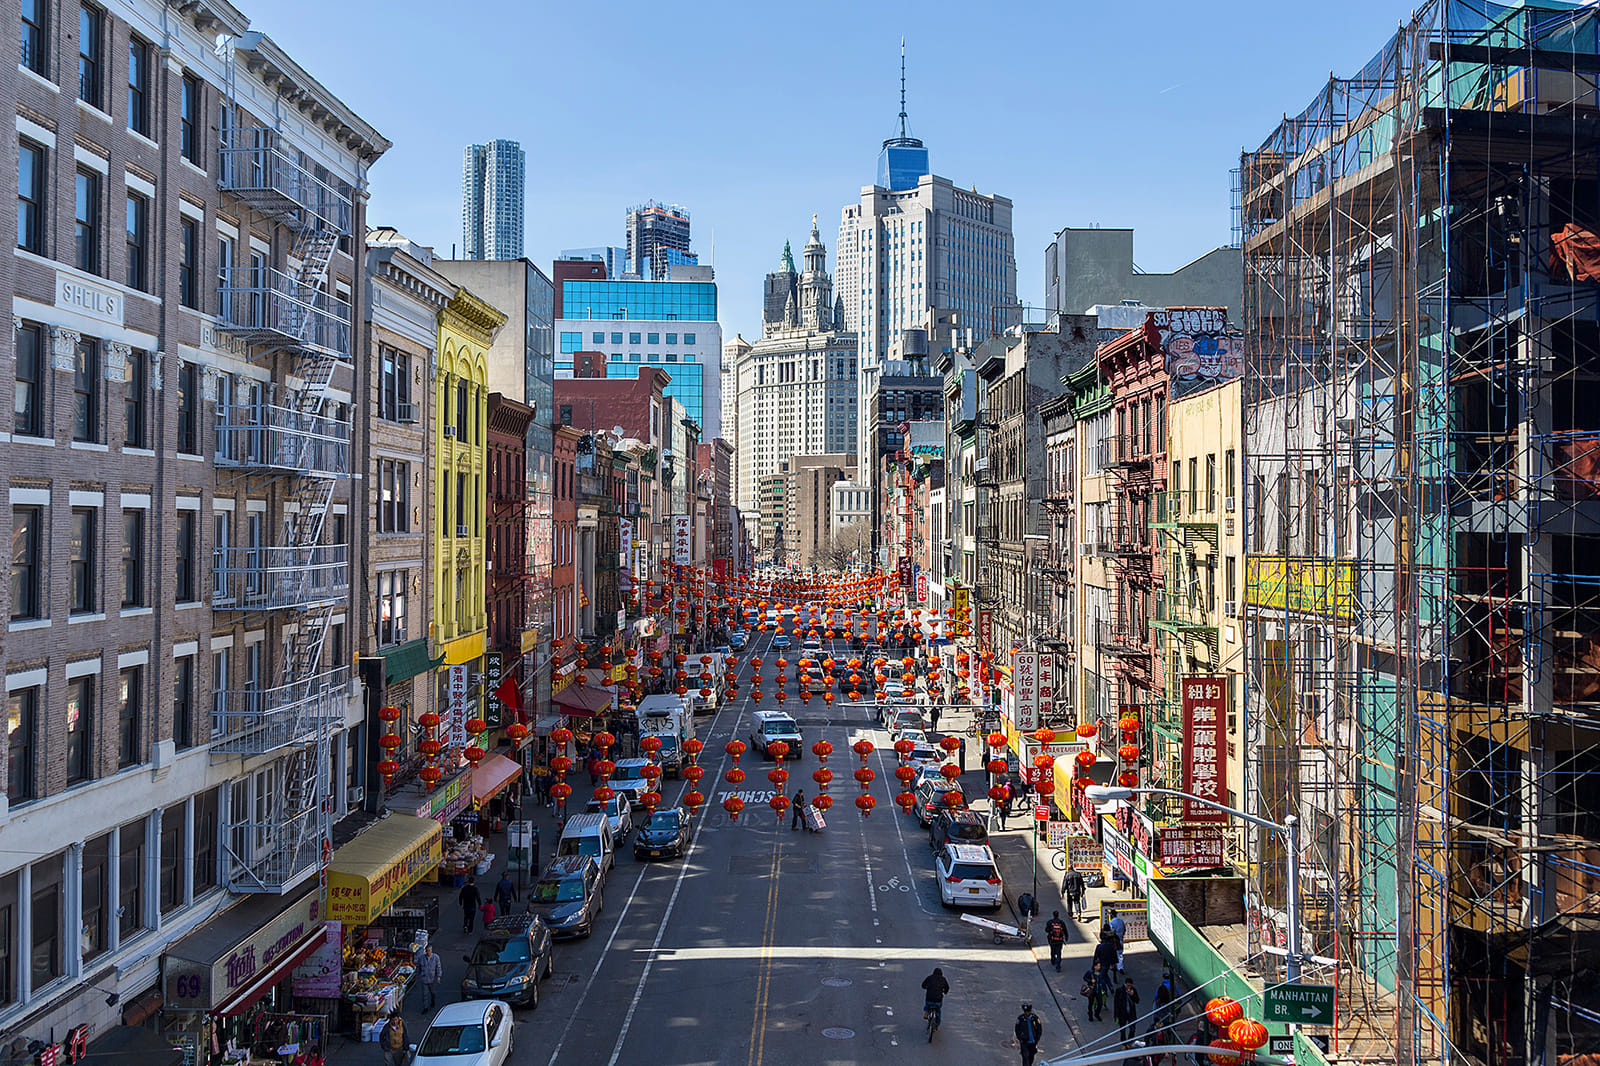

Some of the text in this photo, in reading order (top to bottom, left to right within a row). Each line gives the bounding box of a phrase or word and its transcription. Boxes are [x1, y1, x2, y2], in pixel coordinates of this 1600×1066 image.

[63, 282, 115, 315] SHEILS
[1187, 684, 1221, 700] 紐約
[1192, 706, 1218, 797] 第一駕駛學校
[177, 975, 200, 998] 69
[1270, 989, 1328, 1003] MANHATTAN
[1274, 1004, 1290, 1015] BR.
[1277, 1041, 1294, 1050] ONE
